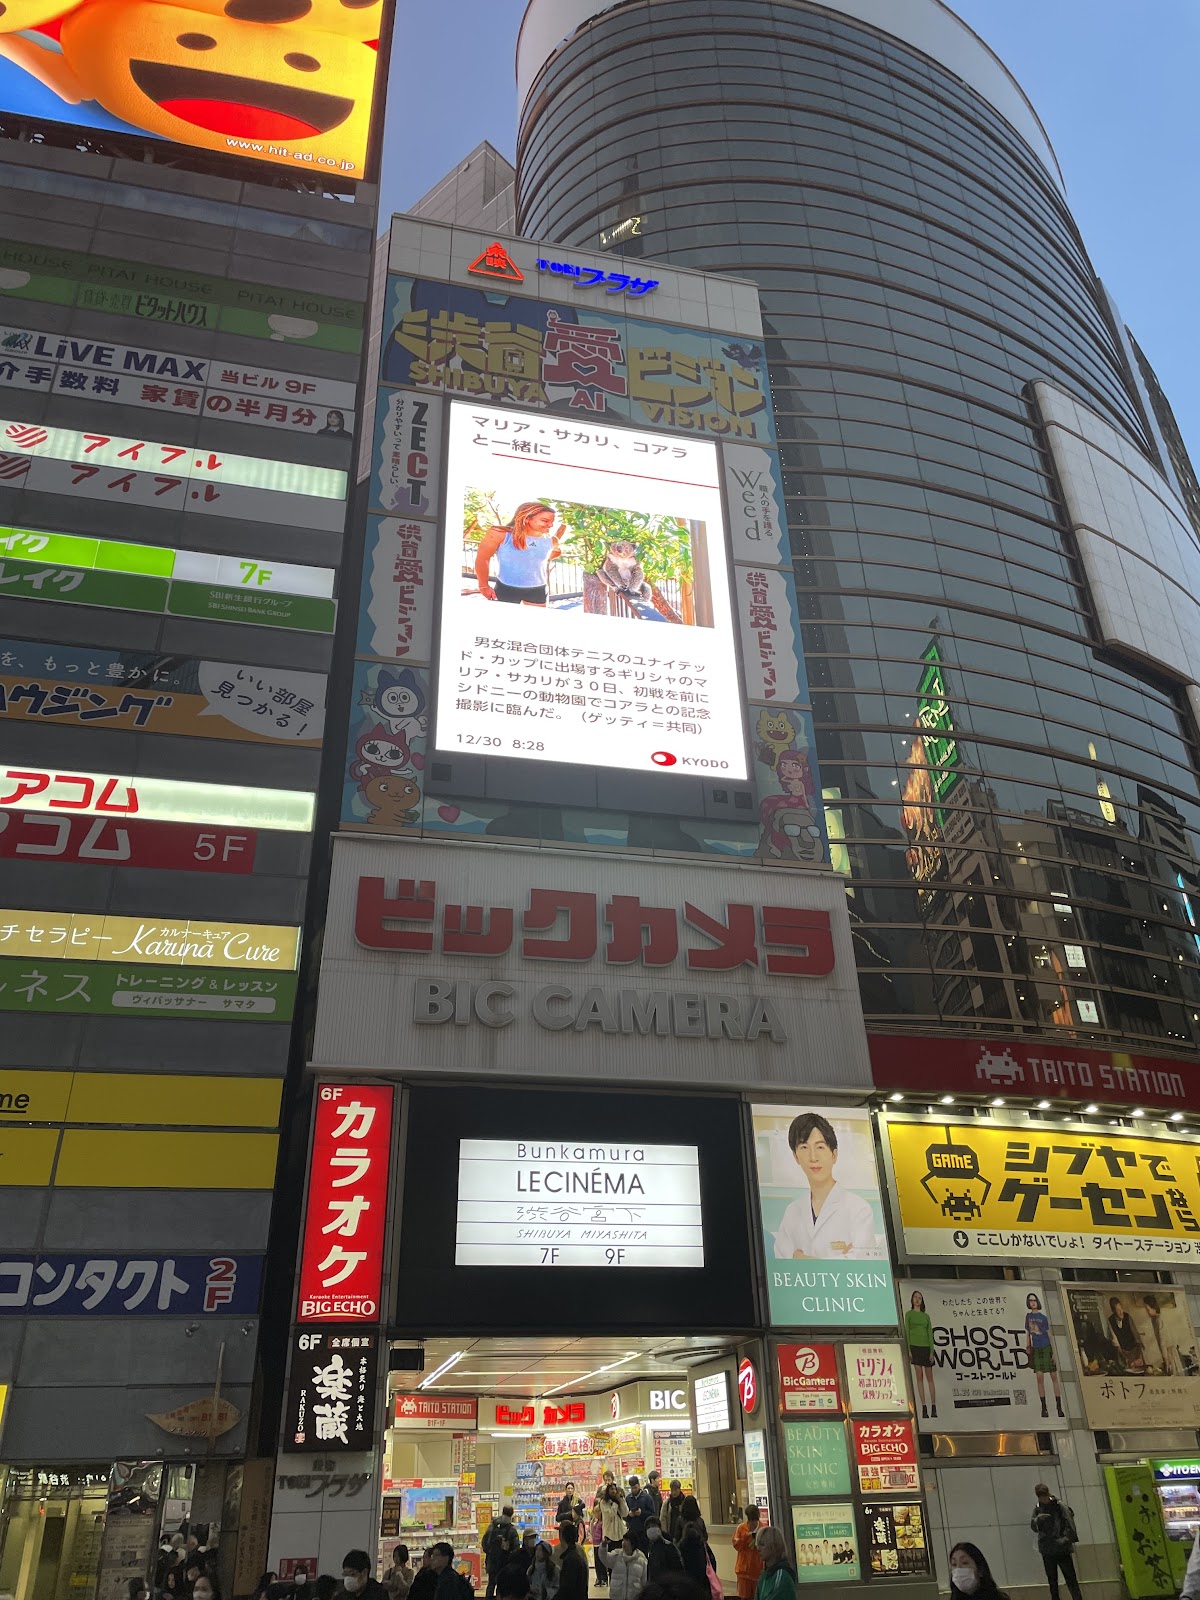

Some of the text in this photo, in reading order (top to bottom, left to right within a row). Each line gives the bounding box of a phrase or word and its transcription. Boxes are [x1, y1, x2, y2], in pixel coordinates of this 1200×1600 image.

[226, 138, 355, 171] www.hit-ad.co.jp
[144, 275, 213, 296] HOUSE
[293, 301, 356, 320] HOUSE
[123, 352, 207, 382] MAX
[409, 361, 757, 438] SHIBUYA AI VISION
[472, 415, 687, 459] マリア・サカリ、コアラ
[472, 433, 552, 456] と一緒に
[407, 401, 428, 506] ZECT
[240, 561, 273, 586] 7F
[236, 669, 315, 717] いい部屋
[456, 733, 545, 751] 12/30 8:28
[682, 756, 729, 769] KYODO
[0, 770, 139, 813] アコム
[0, 811, 247, 862] コム 5F
[354, 875, 836, 978] ビックカメラ
[223, 932, 280, 962] Cure
[0, 969, 92, 1003] ネス
[413, 977, 788, 1043] BIC CAMERA
[1027, 1057, 1093, 1087] TAITO
[320, 1087, 343, 1101] 6F
[517, 1143, 645, 1162] Bunkamura
[932, 1153, 974, 1170] GAME
[1004, 1141, 1176, 1182] シブヤで
[317, 1101, 376, 1288] カラオケ
[517, 1229, 647, 1240] SHIBUYA MIYASHITA
[540, 1248, 625, 1265] 7F 9F
[0, 1258, 237, 1312] コンタクト 2F
[773, 1272, 887, 1288] BEAUTY SKIN
[301, 1300, 376, 1317] BIG ECHO
[802, 1297, 865, 1312] CLINIC
[298, 1334, 323, 1351] 6F
[932, 1325, 1026, 1350] GHOST
[933, 1347, 1030, 1371] WORLD
[312, 1353, 354, 1445] 楽蔵
[650, 1390, 687, 1410] BIC
[1101, 1379, 1146, 1400] ポトフ
[297, 1389, 307, 1432] RAKUZO
[418, 1401, 472, 1415] TAITO STATION
[787, 1427, 841, 1441] BEAUTY
[860, 1424, 905, 1437] カラオケ
[788, 1445, 822, 1458] SKIN
[861, 1443, 908, 1455] BIG ECHO
[790, 1462, 838, 1475] CLINIC
[1173, 1465, 1189, 1475] ITO
